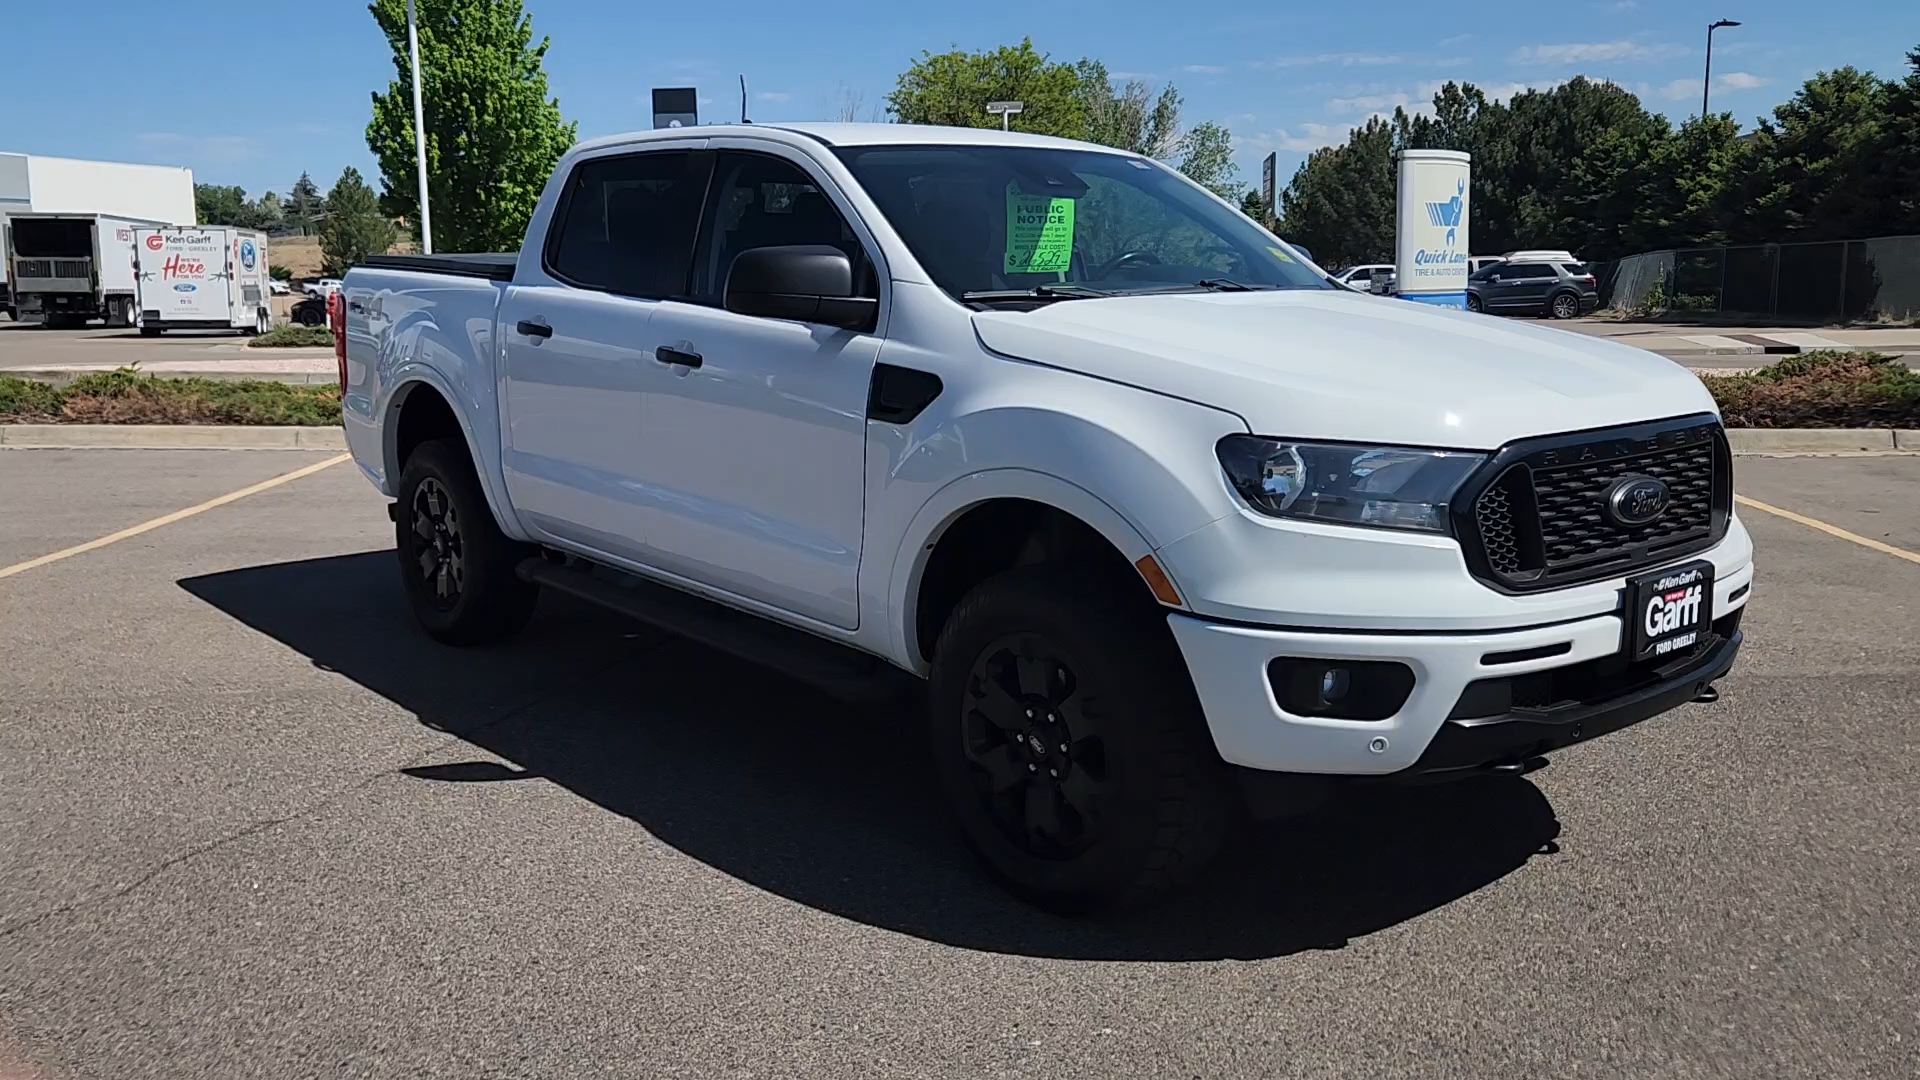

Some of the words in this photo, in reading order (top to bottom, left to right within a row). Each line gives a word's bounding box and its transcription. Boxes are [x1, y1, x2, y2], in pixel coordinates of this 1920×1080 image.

[1016, 205, 1065, 214] PUBLIC
[1017, 215, 1066, 224] NOTICE
[165, 235, 185, 244] Ken
[186, 235, 211, 244] Garff
[1008, 254, 1017, 266] $
[1414, 249, 1448, 265] Quick
[1448, 250, 1467, 264] Lane
[162, 253, 206, 281] Here
[1414, 268, 1430, 277] TIRE
[1436, 268, 1451, 276] AUTO
[175, 283, 195, 292] Ford
[1631, 488, 1663, 515] Ford
[1664, 576, 1679, 590] Ken
[1679, 569, 1698, 584] Garff
[1645, 583, 1702, 638] Garff
[1656, 638, 1672, 656] FORD
[1672, 631, 1698, 650] GREELEY
